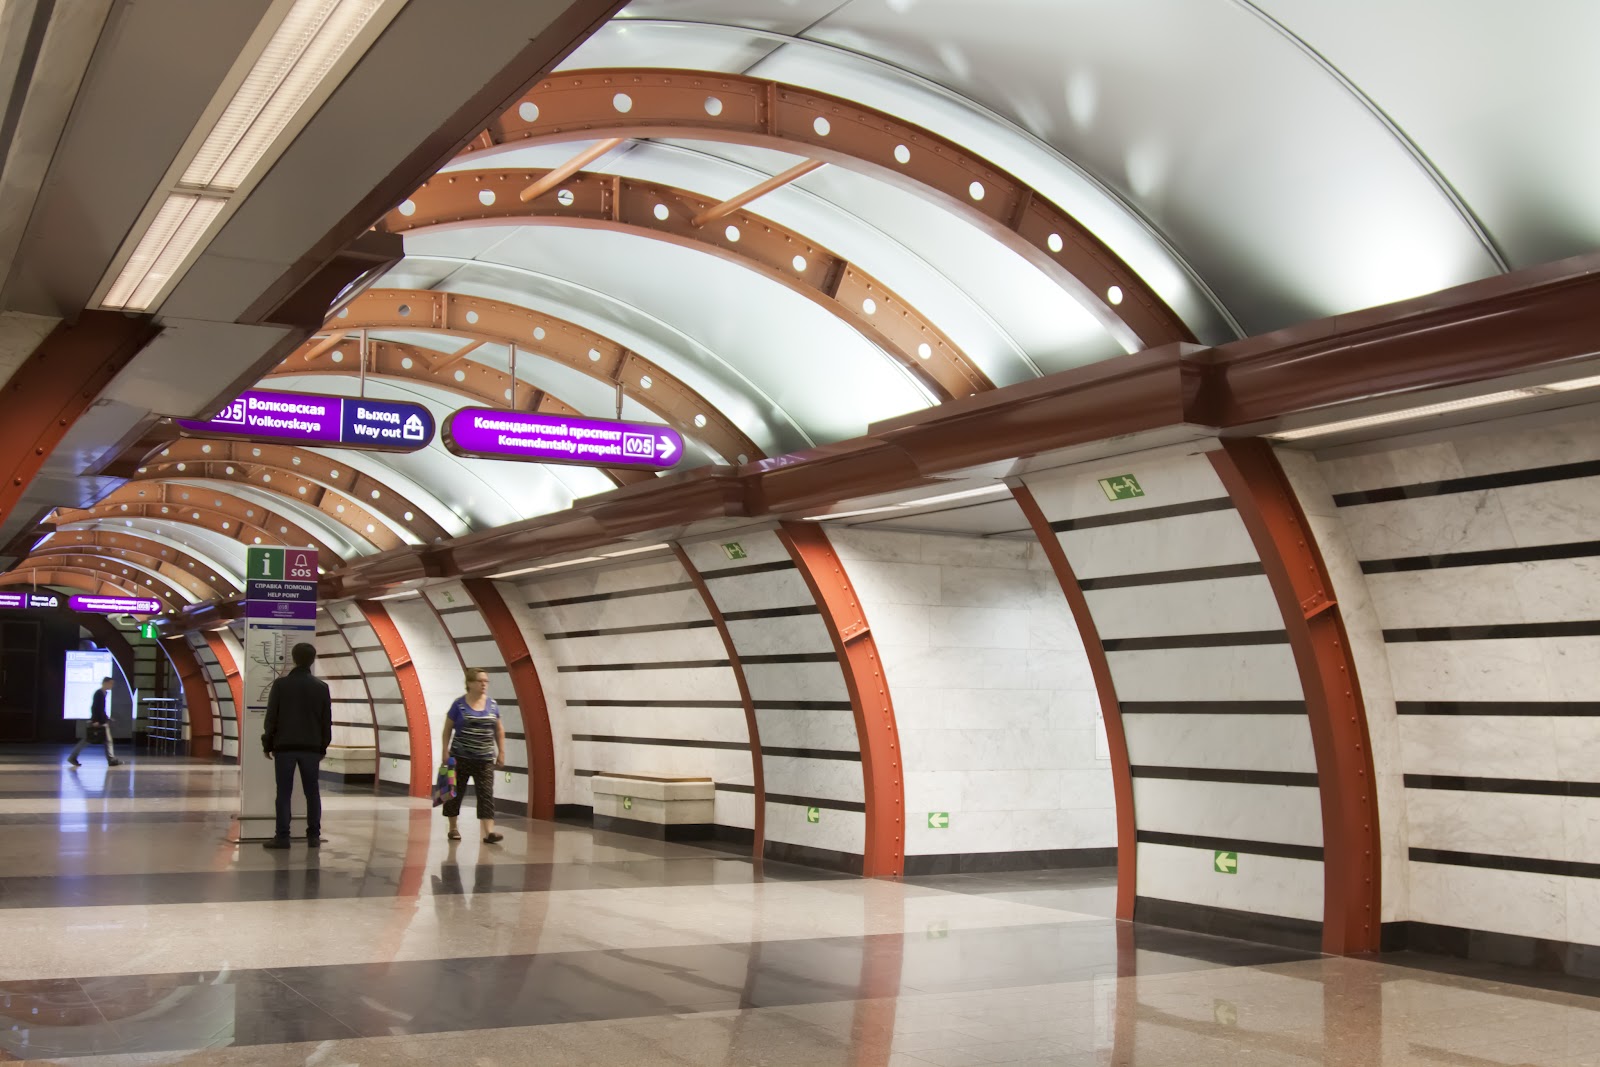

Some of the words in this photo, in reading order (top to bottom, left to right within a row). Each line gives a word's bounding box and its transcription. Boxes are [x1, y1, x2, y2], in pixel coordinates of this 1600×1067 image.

[248, 397, 326, 416] Волковская
[357, 407, 400, 424] Выход
[247, 414, 321, 433] Volkovskaya
[353, 423, 380, 438] Way
[381, 427, 402, 438] out
[474, 416, 569, 436] Комендантский
[569, 427, 622, 441] проспект
[498, 434, 577, 454] Komendantskiy
[577, 443, 622, 456] prospekt
[291, 568, 312, 578] SOS
